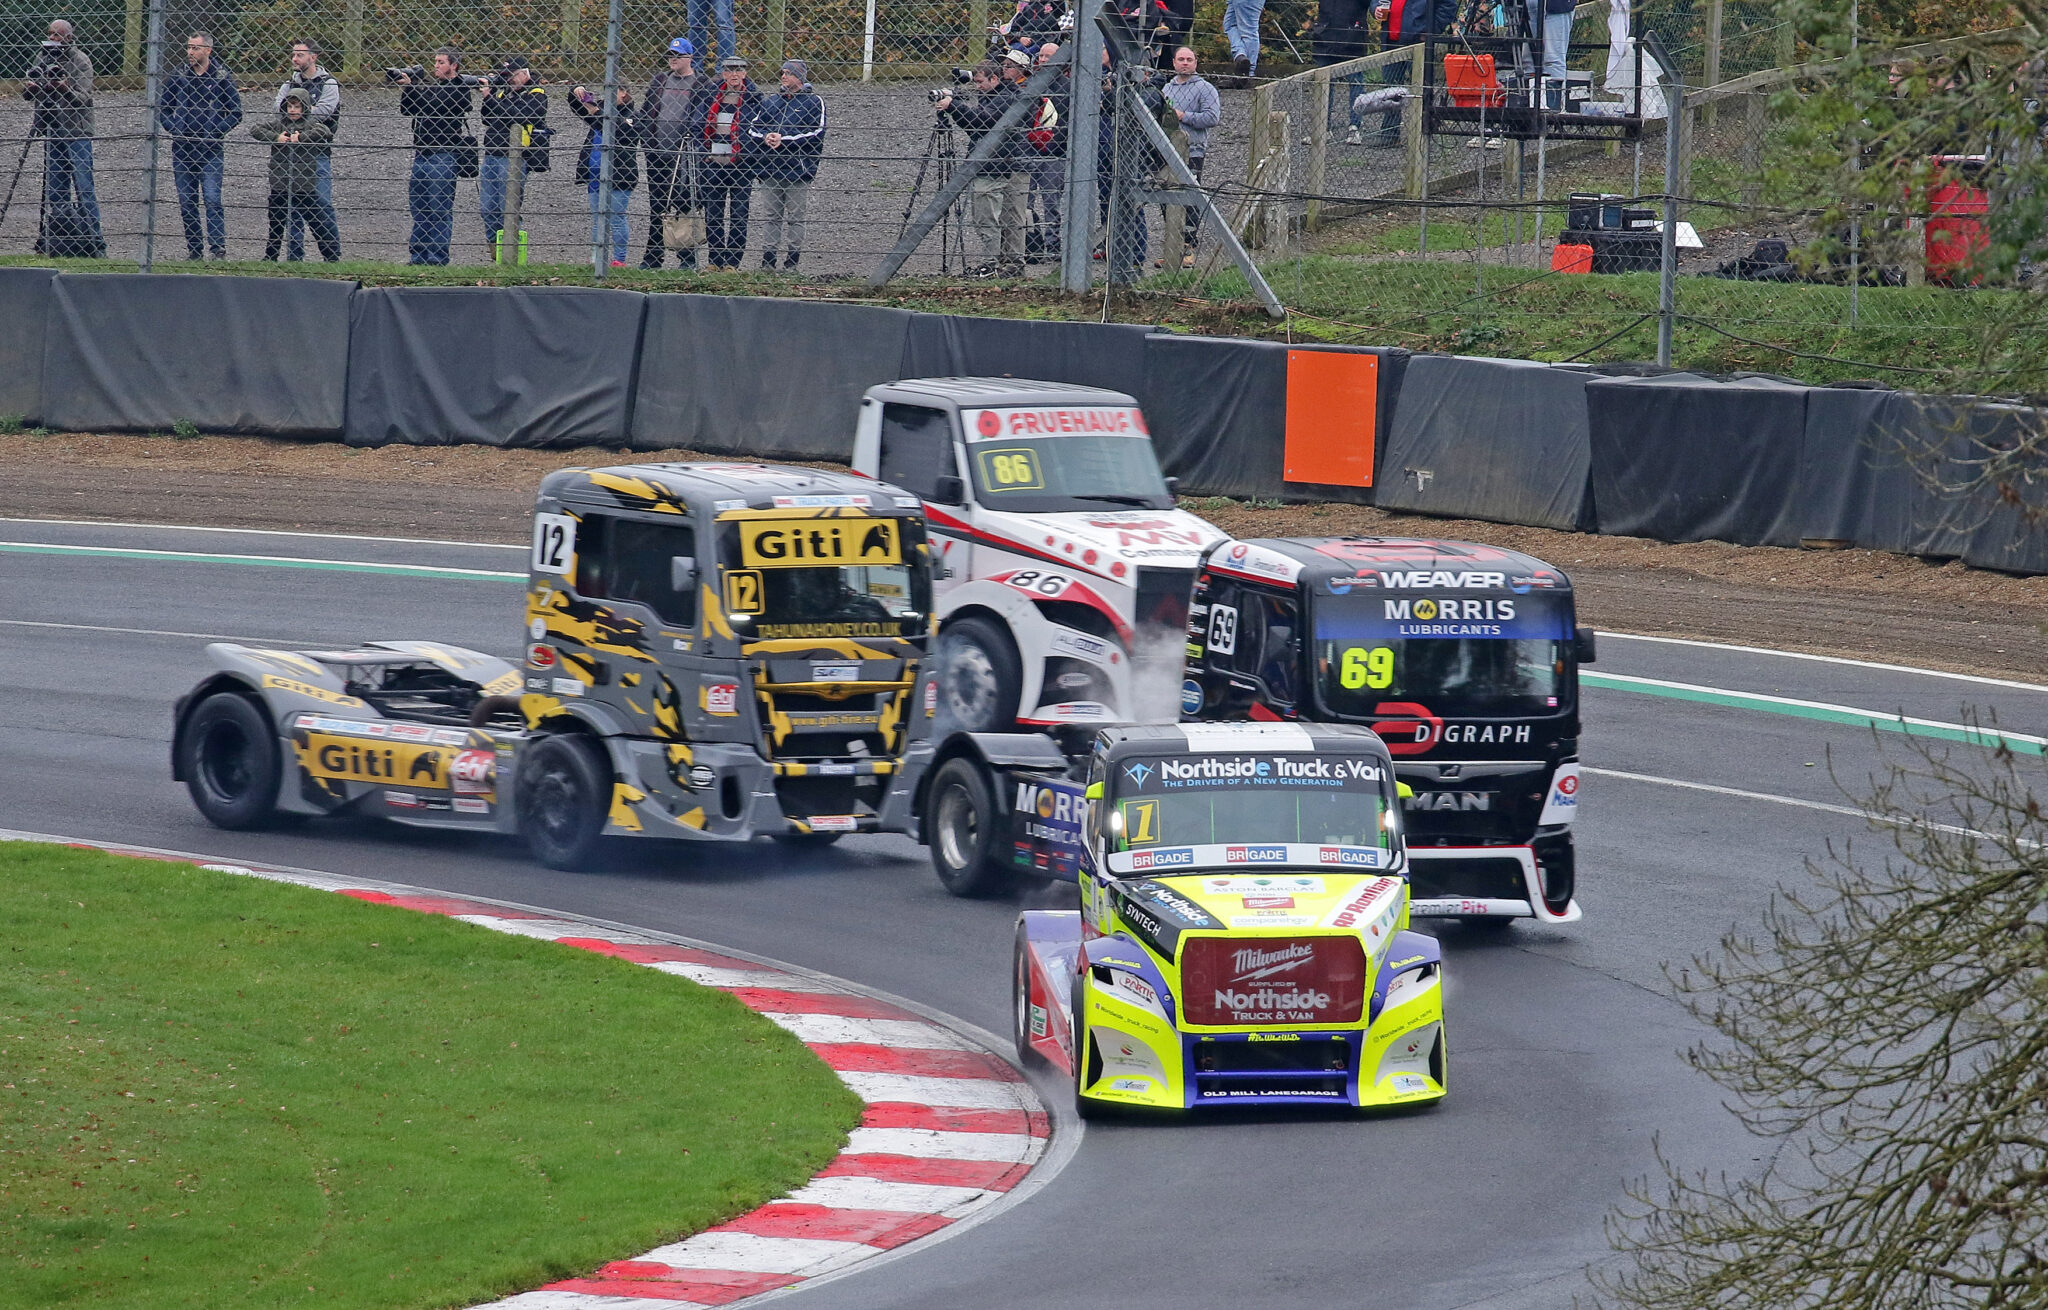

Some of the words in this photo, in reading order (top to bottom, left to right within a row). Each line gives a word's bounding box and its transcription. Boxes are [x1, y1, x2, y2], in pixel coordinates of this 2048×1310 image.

[1009, 410, 1129, 435] FRUEHAUF
[992, 454, 1033, 484] 86
[541, 523, 564, 567] 12
[755, 528, 842, 559] Giti
[1011, 571, 1067, 595] 86
[1381, 571, 1505, 588] WEAVER
[729, 575, 758, 610] 12
[1384, 599, 1516, 620] MORRIS
[757, 624, 901, 638] TAHUNAHONEY.CO.UK
[1211, 609, 1234, 649] 69
[1400, 624, 1501, 636] LUBRICANTS
[1340, 647, 1395, 690] 69
[271, 676, 324, 700] Giti
[1414, 725, 1531, 743] DIGRAPH
[319, 745, 394, 778] Giti
[1161, 757, 1271, 779] Northside
[1273, 757, 1330, 778] Truck
[1335, 767, 1347, 778] &
[1346, 759, 1387, 782] Van
[1186, 778, 1225, 787] DRIVER
[1227, 778, 1241, 786] OF
[1254, 778, 1277, 786] NEW
[1279, 778, 1344, 786] GENERATION
[1015, 782, 1086, 824] MORR
[1405, 792, 1490, 811] MAN
[1025, 821, 1081, 846] LUBRICA
[1131, 803, 1155, 843] 1
[1134, 853, 1191, 867] BRIGADE
[1227, 848, 1286, 862] BRIGADE
[1321, 850, 1377, 865] BRIGADE
[1150, 889, 1209, 926] Northside
[1347, 877, 1399, 914] Roofing
[1126, 904, 1162, 936] SYNTECH
[1231, 943, 1313, 974] Milwaukee
[1215, 988, 1331, 1009] Northside
[1232, 1011, 1273, 1021] TRUCK
[1275, 1011, 1286, 1020] &
[1289, 1011, 1314, 1020] VAN
